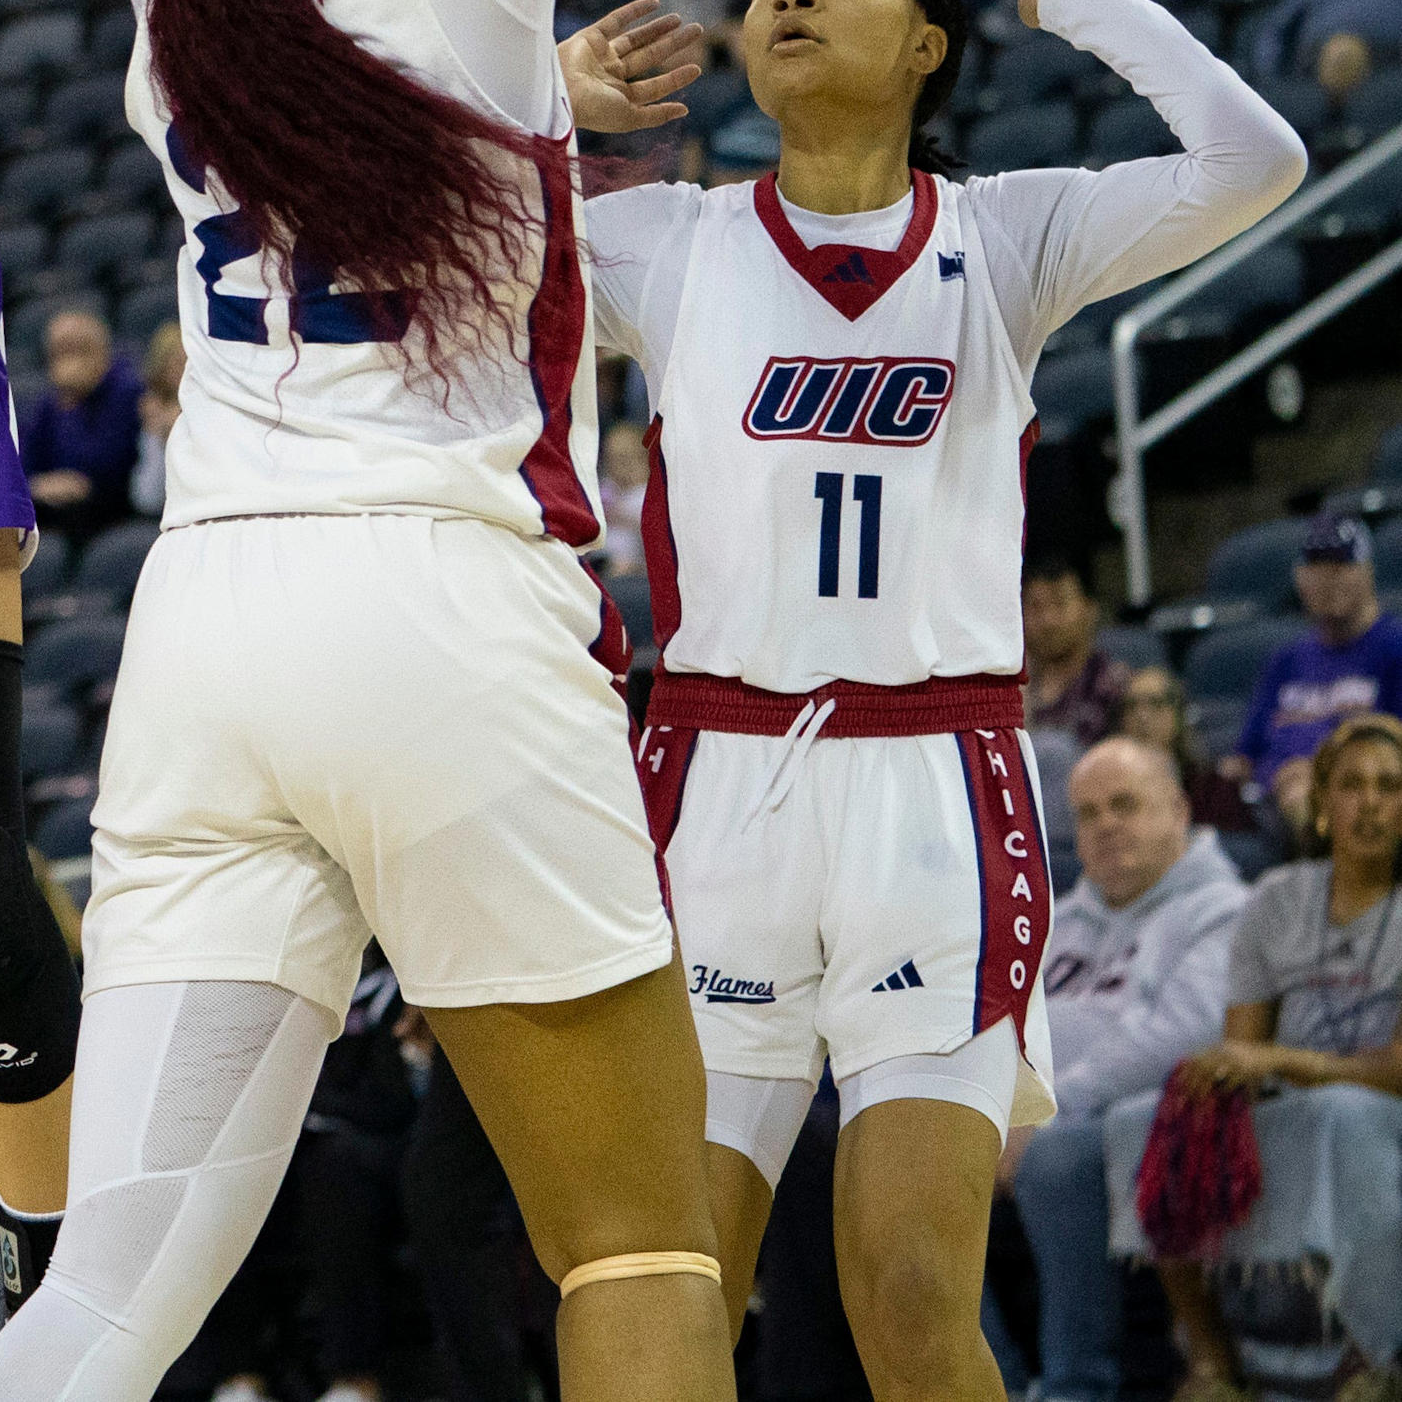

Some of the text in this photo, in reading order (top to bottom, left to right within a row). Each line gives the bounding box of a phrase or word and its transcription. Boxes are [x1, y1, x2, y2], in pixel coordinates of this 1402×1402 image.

[745, 358, 954, 446] UIC
[814, 472, 882, 599] 11
[974, 728, 1032, 990] HICAGO
[689, 964, 776, 997] Flames
